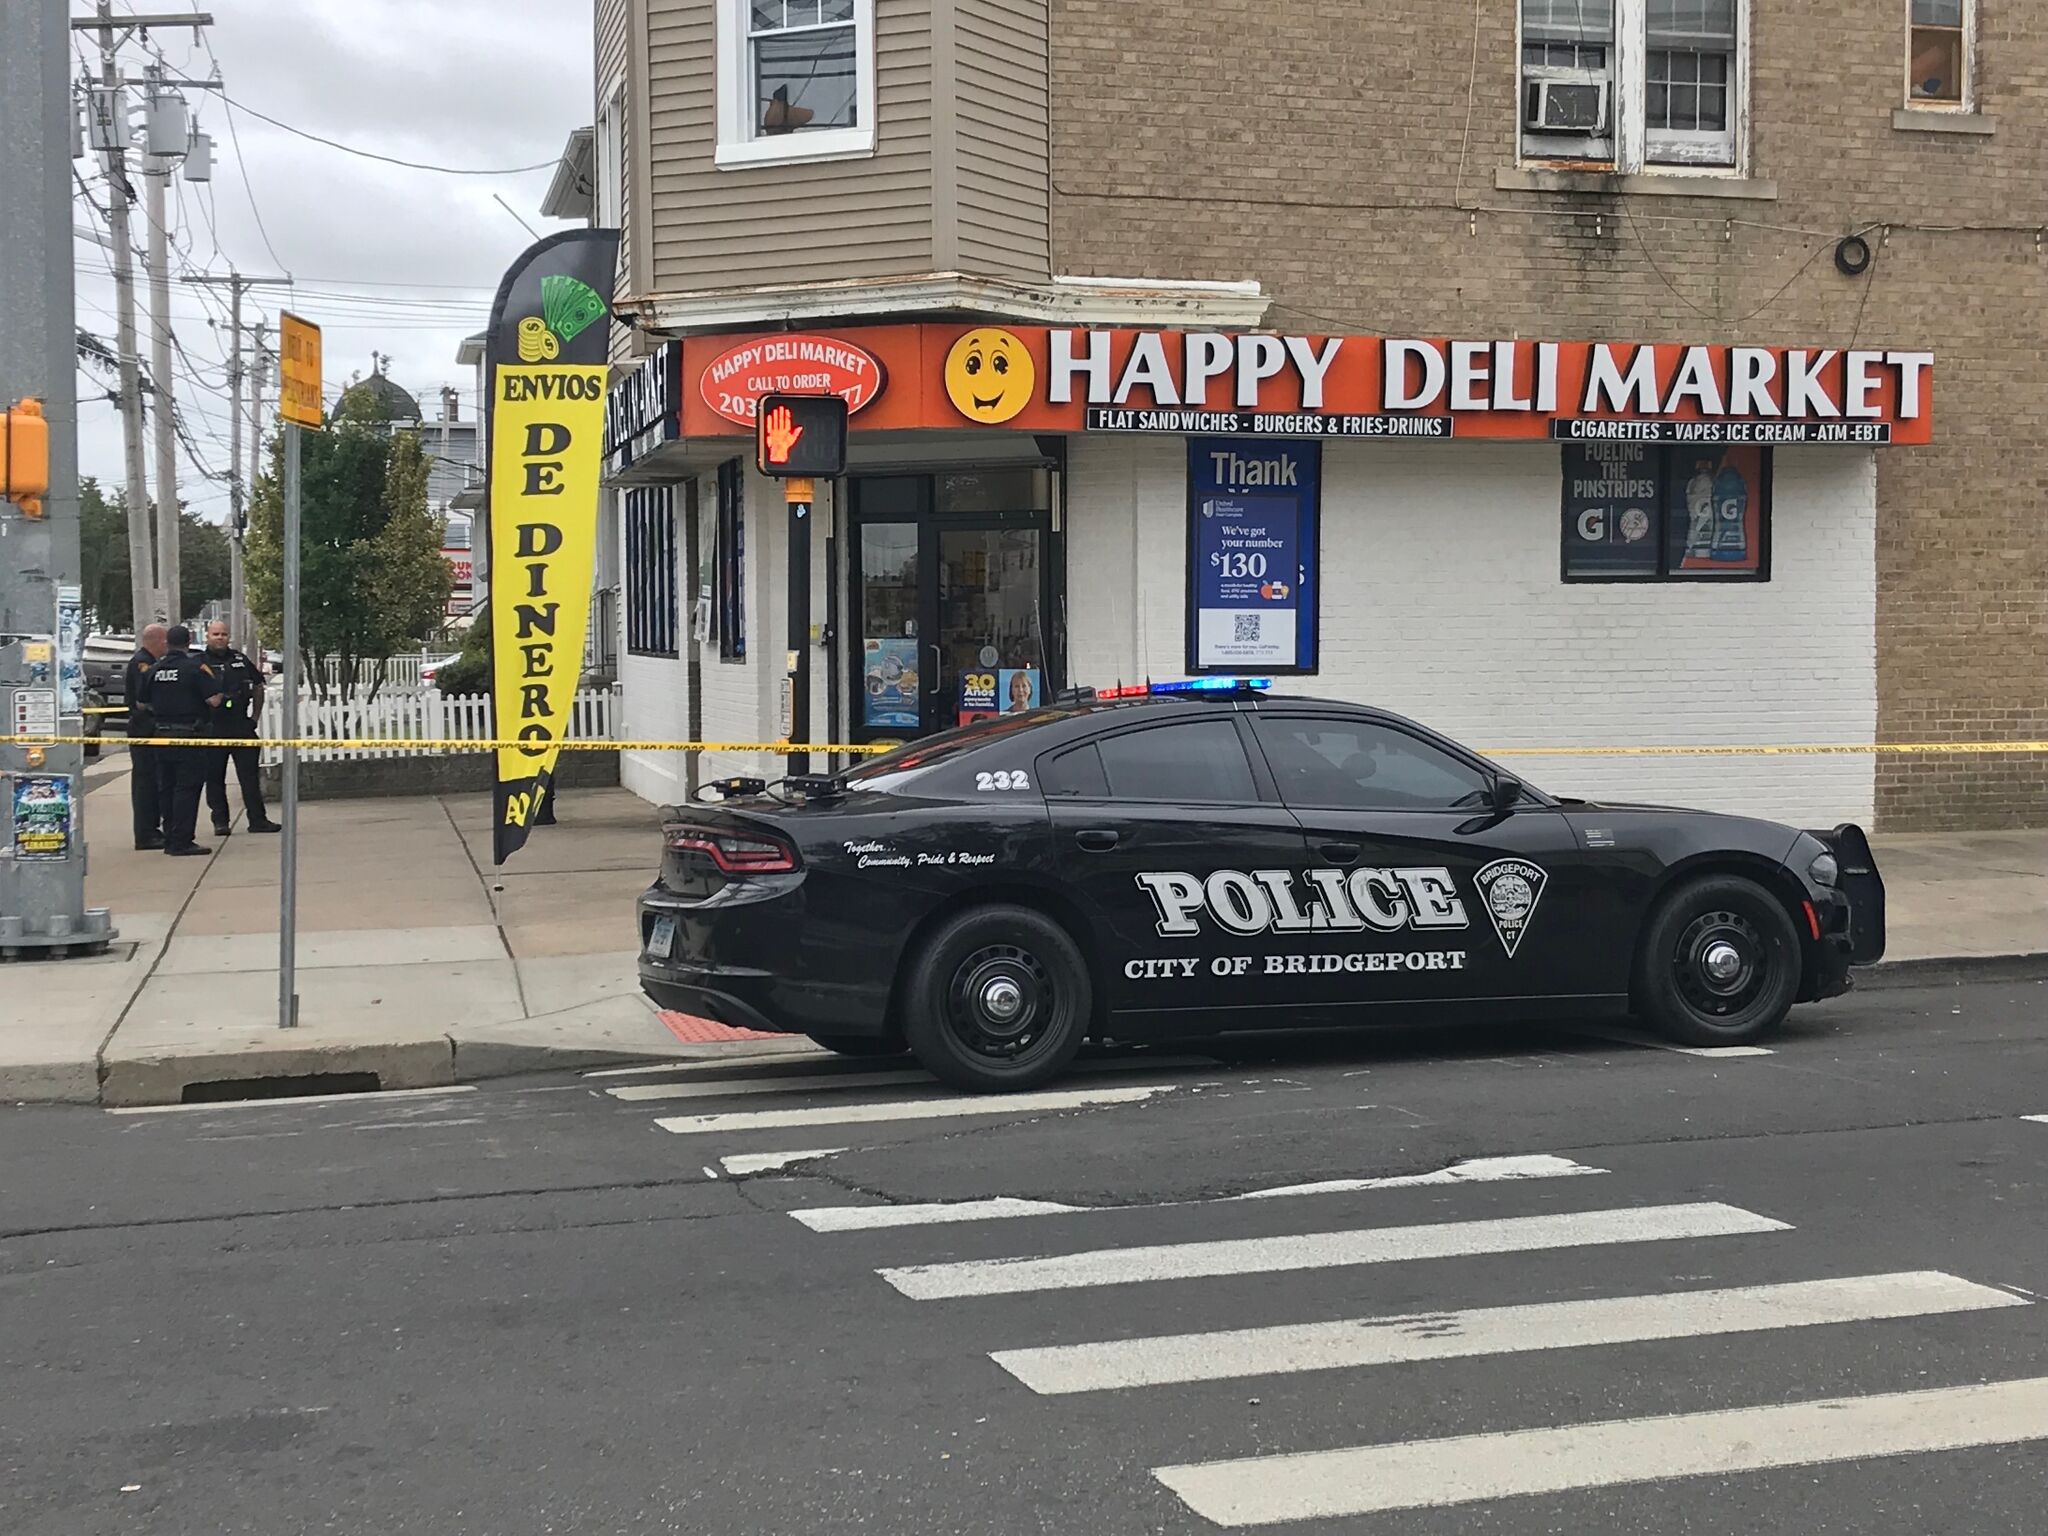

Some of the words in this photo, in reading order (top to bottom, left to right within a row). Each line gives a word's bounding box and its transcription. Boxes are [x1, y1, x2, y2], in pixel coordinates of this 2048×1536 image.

[711, 345, 763, 384] HAPPY
[765, 342, 798, 363] DELI
[800, 342, 867, 376] MARKET
[747, 377, 774, 391] CALL
[776, 375, 791, 390] TO
[793, 373, 831, 389] ORDER
[1049, 329, 1344, 409] HAPPY
[1384, 339, 1559, 412] DELI
[1583, 343, 1935, 419] MARKET
[503, 374, 602, 402] ENVIOS
[1099, 410, 1135, 429] FLAT
[1138, 411, 1239, 432] SANDWICHES
[1253, 414, 1323, 434] BURGERS
[1327, 417, 1338, 434] &
[1343, 416, 1442, 436] FRIES-DRINKS
[1570, 420, 1660, 440] CIGARETTES
[1754, 424, 1806, 441] CREAM
[520, 423, 572, 496] DE
[1585, 443, 1644, 462] FUELING
[1209, 451, 1298, 486] Thank
[1601, 461, 1628, 480] THE
[1573, 479, 1654, 499] PINSTRIPES
[1221, 525, 1250, 536] We've
[1250, 527, 1266, 538] got
[1577, 507, 1605, 541] G
[1221, 539, 1245, 550] your
[1245, 537, 1284, 548] number
[1210, 551, 1268, 578] $130
[513, 522, 563, 757] DINERO
[154, 669, 179, 682] POLICE
[964, 673, 996, 690] 30
[963, 686, 996, 697] Años
[975, 770, 1030, 791] 232
[917, 852, 945, 866] Pride
[947, 852, 956, 864] &
[958, 852, 996, 866] Respect
[1480, 863, 1541, 885] BRIDGEPORT
[1134, 866, 1470, 938] POLICE
[1498, 919, 1523, 929] POLICE
[1506, 930, 1516, 940] CT
[1124, 958, 1199, 979] CITY
[1211, 956, 1252, 977] OF
[1263, 951, 1466, 974] BRIDGEPORT
